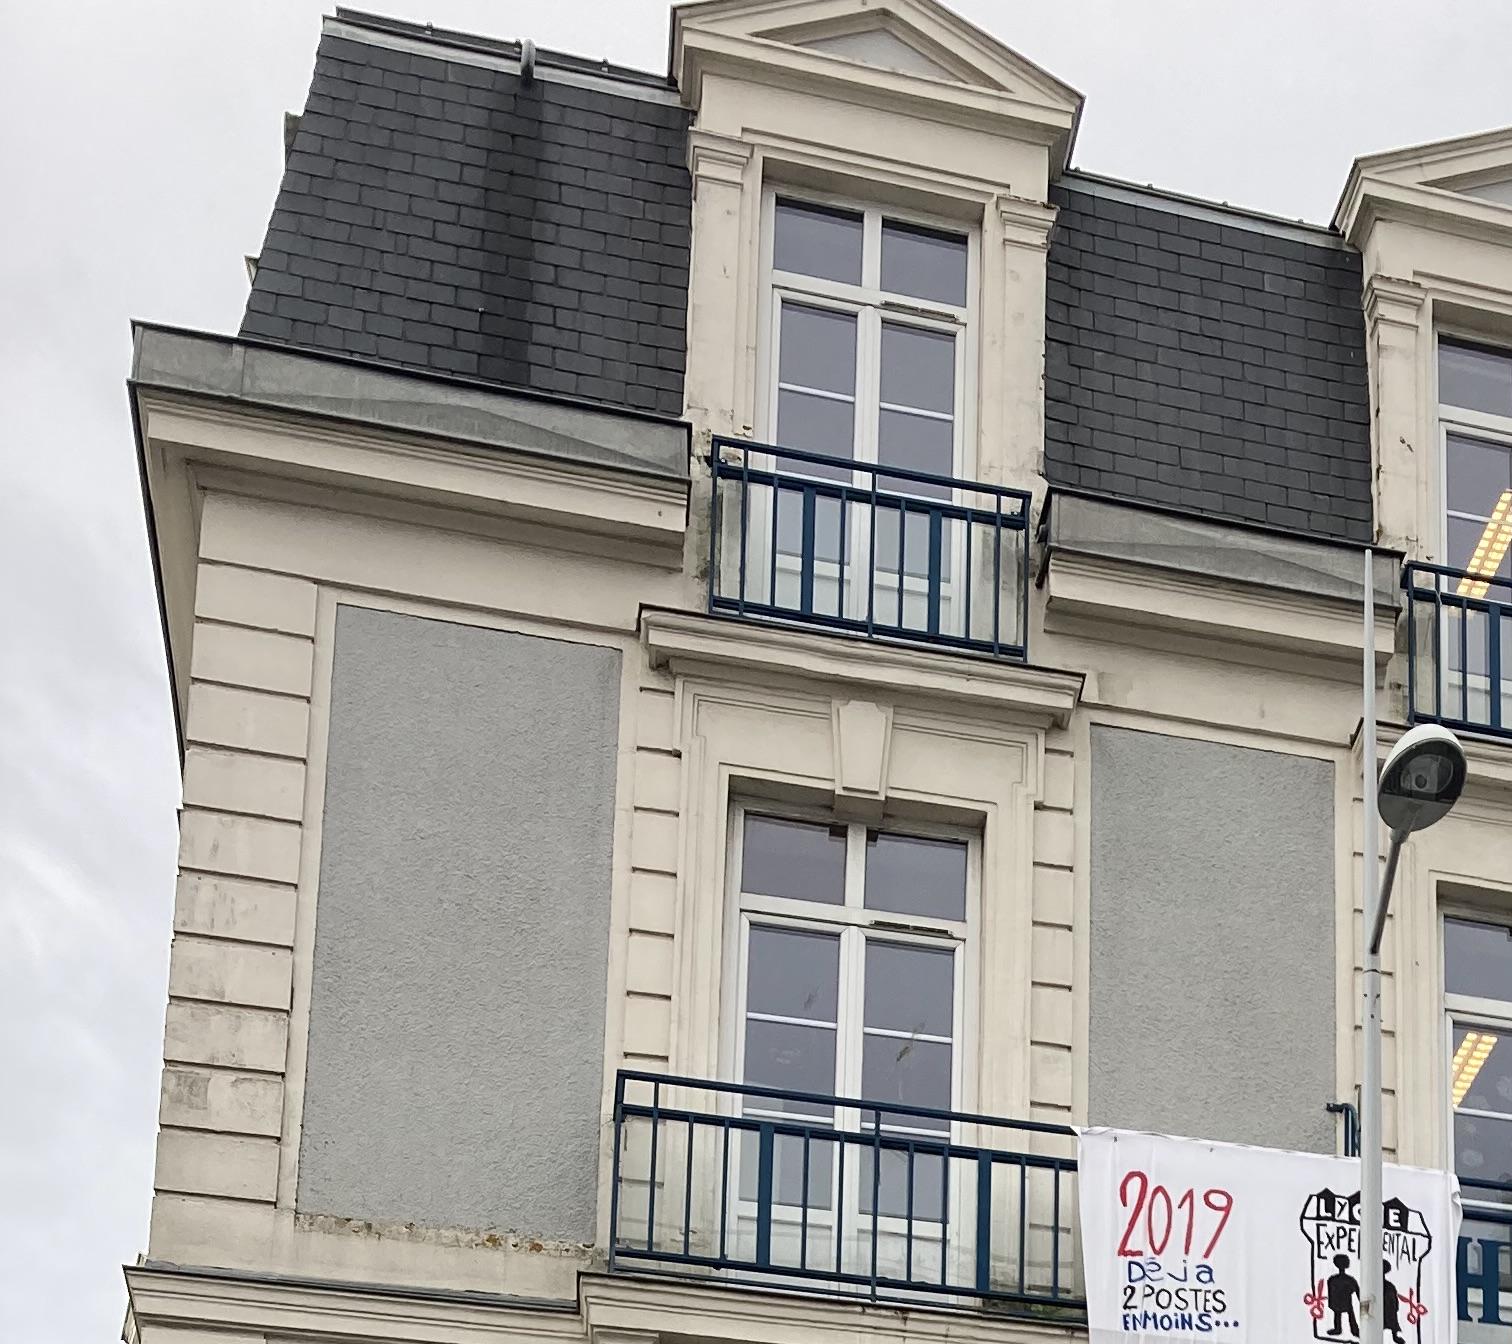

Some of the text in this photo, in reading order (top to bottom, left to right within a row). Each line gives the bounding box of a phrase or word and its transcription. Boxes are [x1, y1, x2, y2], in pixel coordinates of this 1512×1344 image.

[1117, 1171, 1234, 1259] 2019
[1319, 1198, 1401, 1228] LYCE
[1123, 1284, 1227, 1314] 2 POSTES
